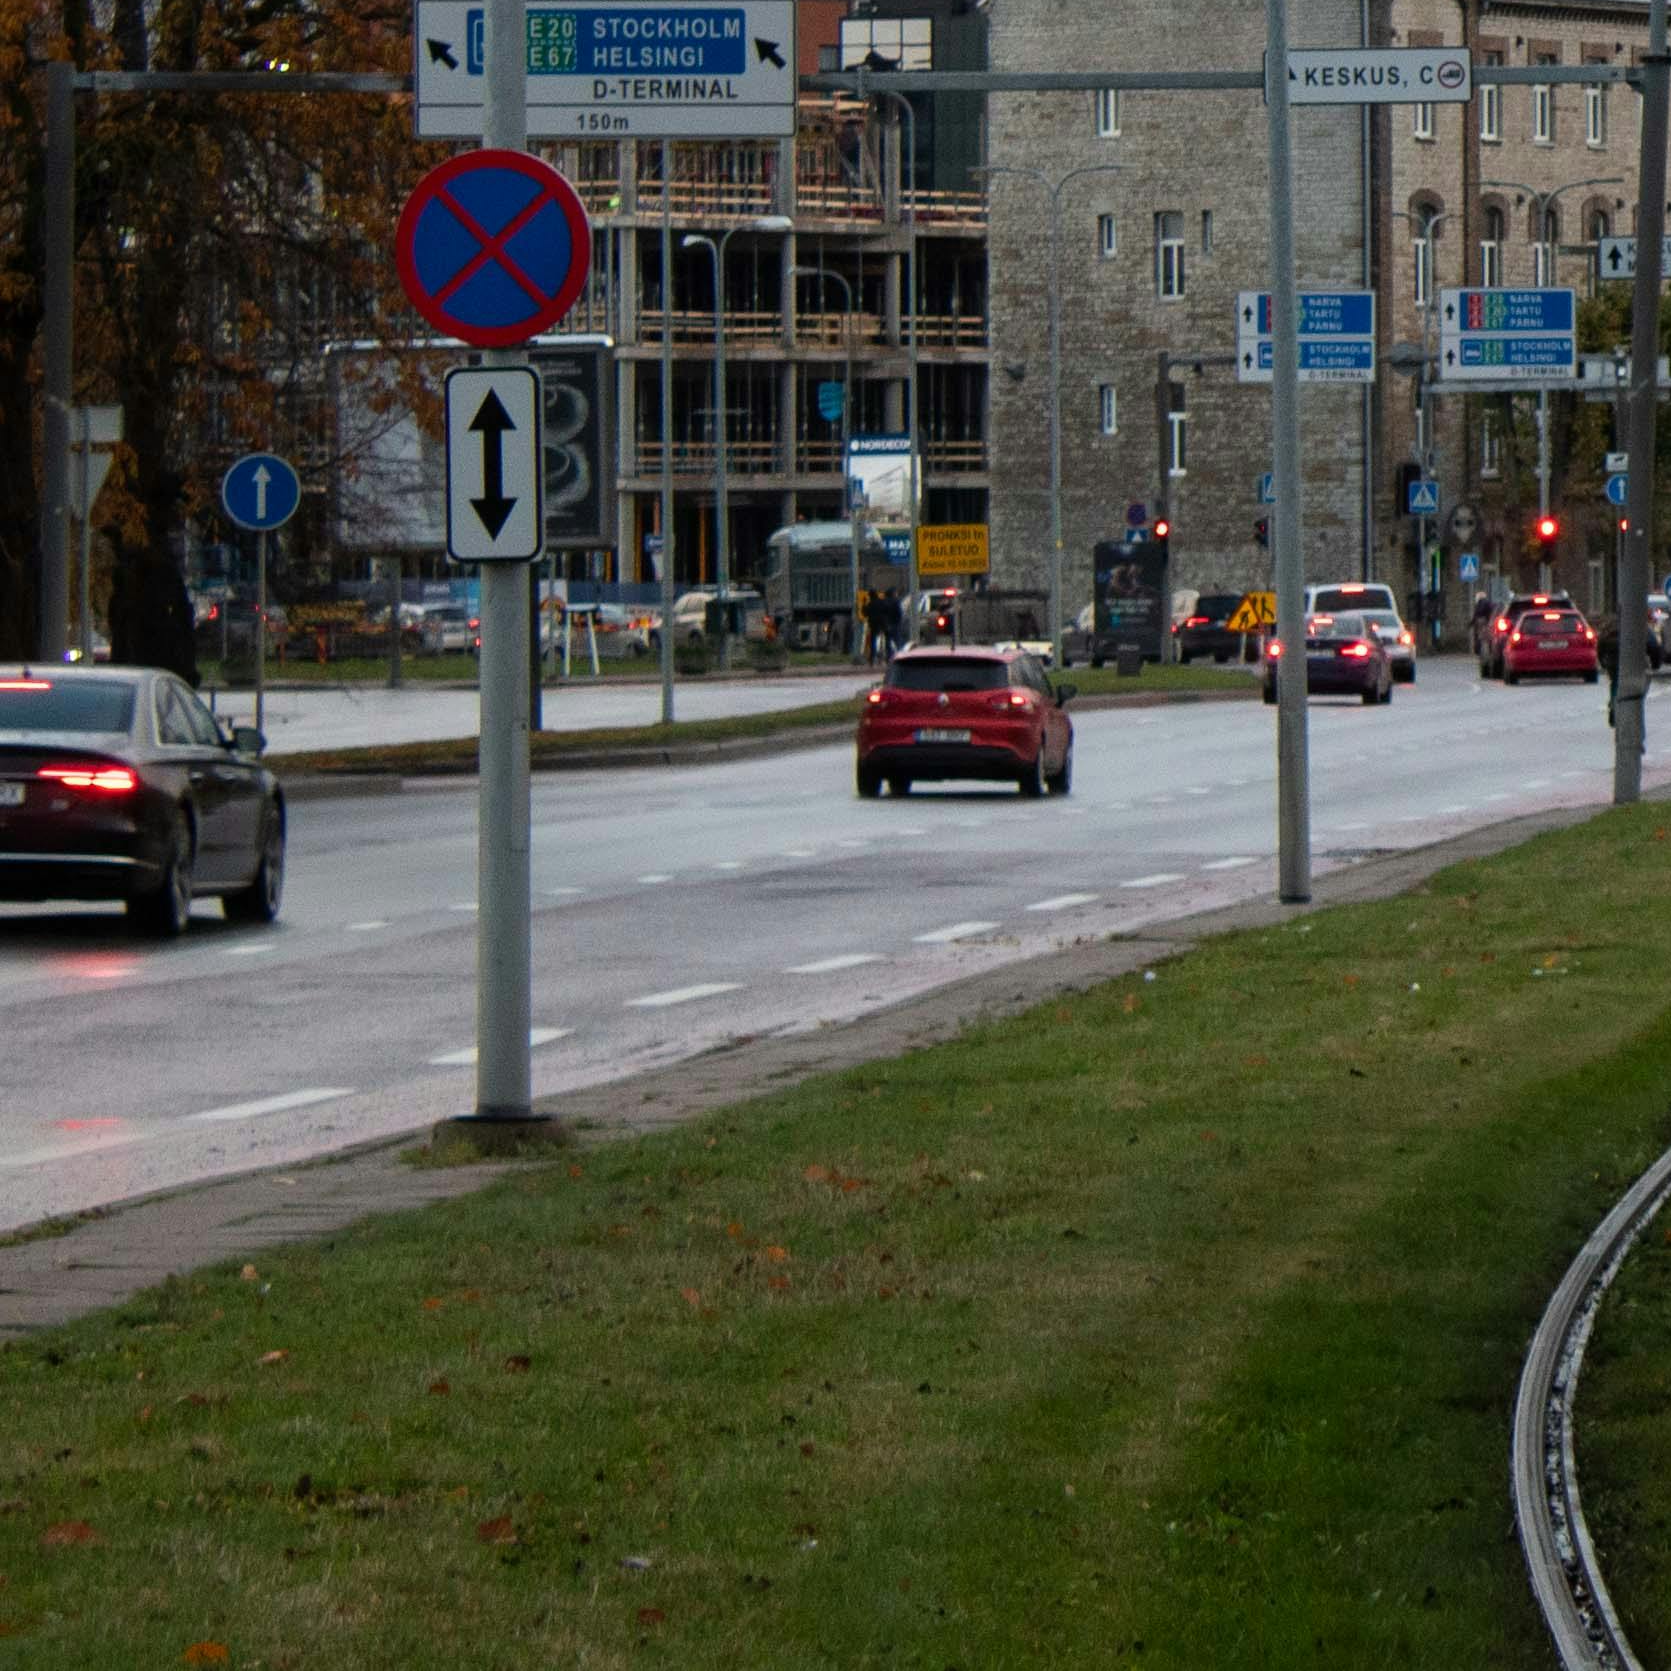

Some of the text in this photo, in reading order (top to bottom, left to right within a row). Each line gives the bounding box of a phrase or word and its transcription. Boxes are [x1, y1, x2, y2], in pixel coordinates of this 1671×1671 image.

[530, 18, 740, 39] E 20 STOCKHOLM
[530, 46, 703, 68] E 67 HELSINGI
[1304, 65, 1433, 88] KESKUS, C
[593, 79, 738, 100] D-TERMINAL
[577, 113, 629, 131] 150m
[1309, 297, 1342, 306] NARVA
[1510, 294, 1543, 304] NARVA
[1309, 309, 1341, 318] TARTU
[1510, 306, 1542, 315] TARTU
